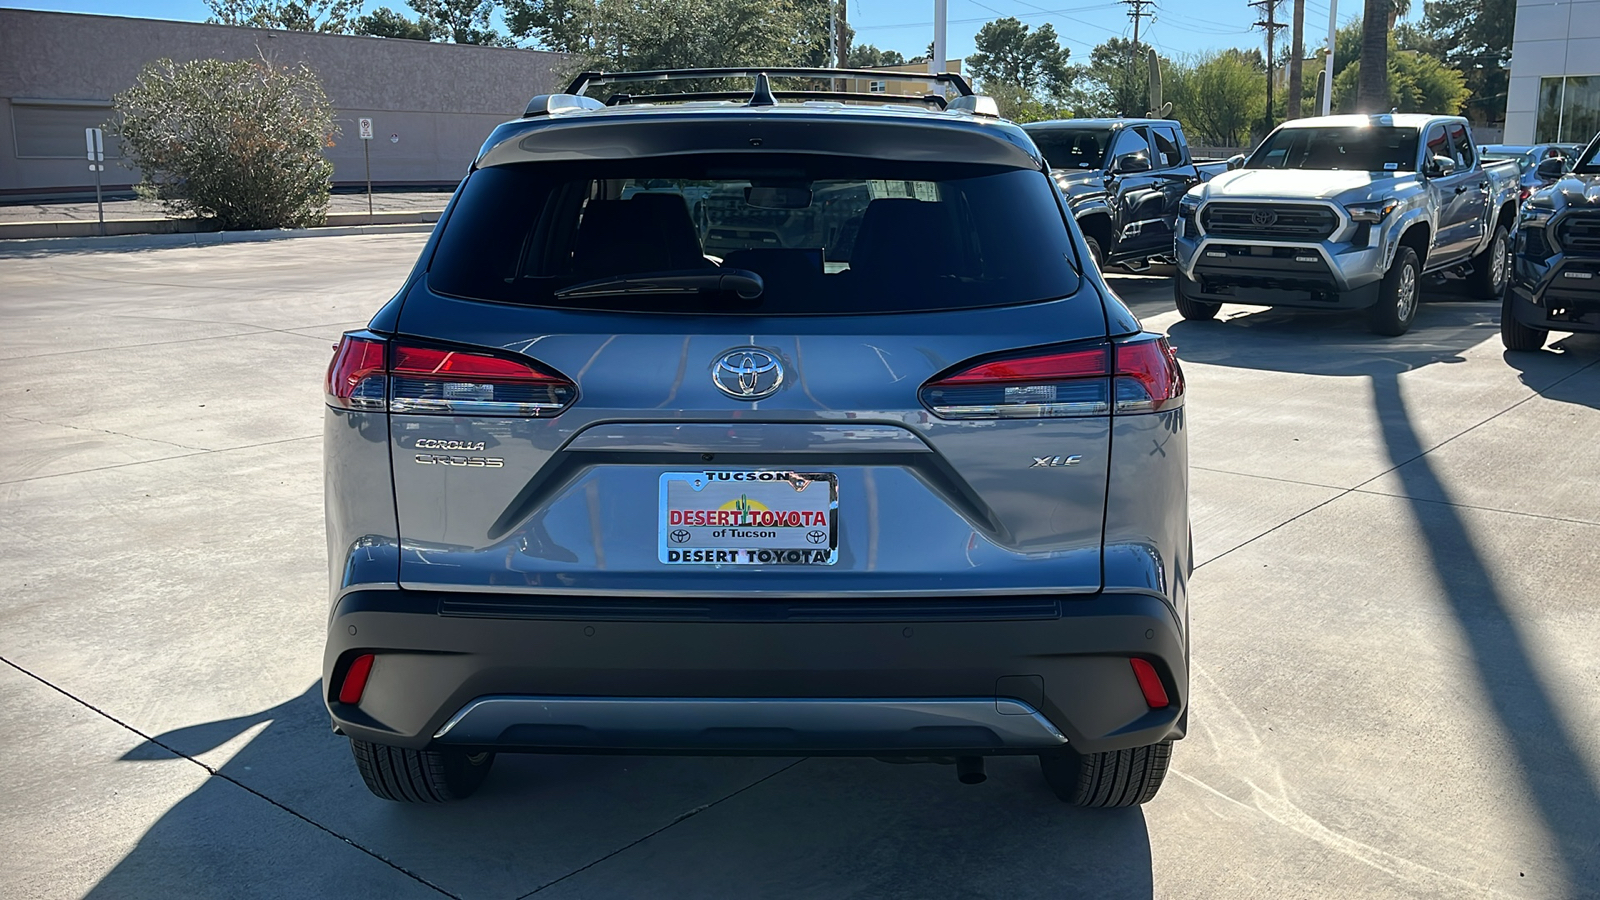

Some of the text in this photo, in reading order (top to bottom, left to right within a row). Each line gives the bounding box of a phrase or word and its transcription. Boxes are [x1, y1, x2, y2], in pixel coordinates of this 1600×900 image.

[415, 438, 485, 451] COROLLA
[415, 454, 504, 468] CROSS
[1029, 454, 1082, 468] XLE
[706, 472, 789, 481] TUCSON
[670, 510, 826, 526] DESERT TOYOTA
[713, 528, 776, 538] of Tucson
[668, 550, 826, 563] DESERT TOYOTA
